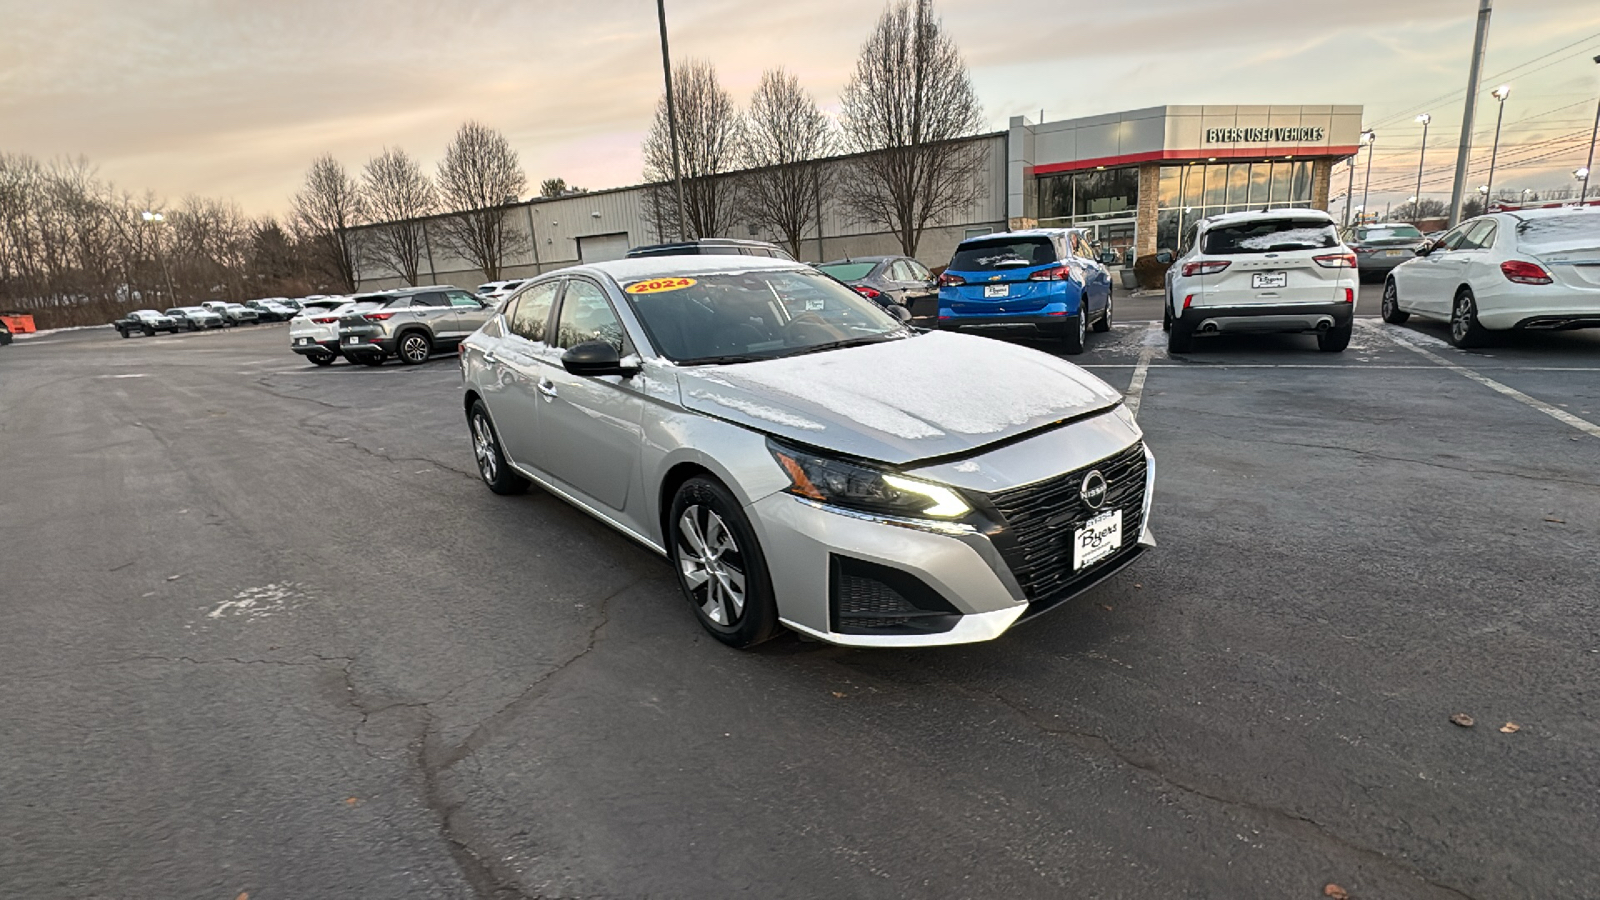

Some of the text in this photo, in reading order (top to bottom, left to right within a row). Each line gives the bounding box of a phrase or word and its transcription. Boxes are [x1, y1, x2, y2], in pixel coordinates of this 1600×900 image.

[1206, 126, 1325, 143] BYERS USED VEHICLES
[634, 279, 690, 292] 2024
[1078, 523, 1117, 548] Byers
